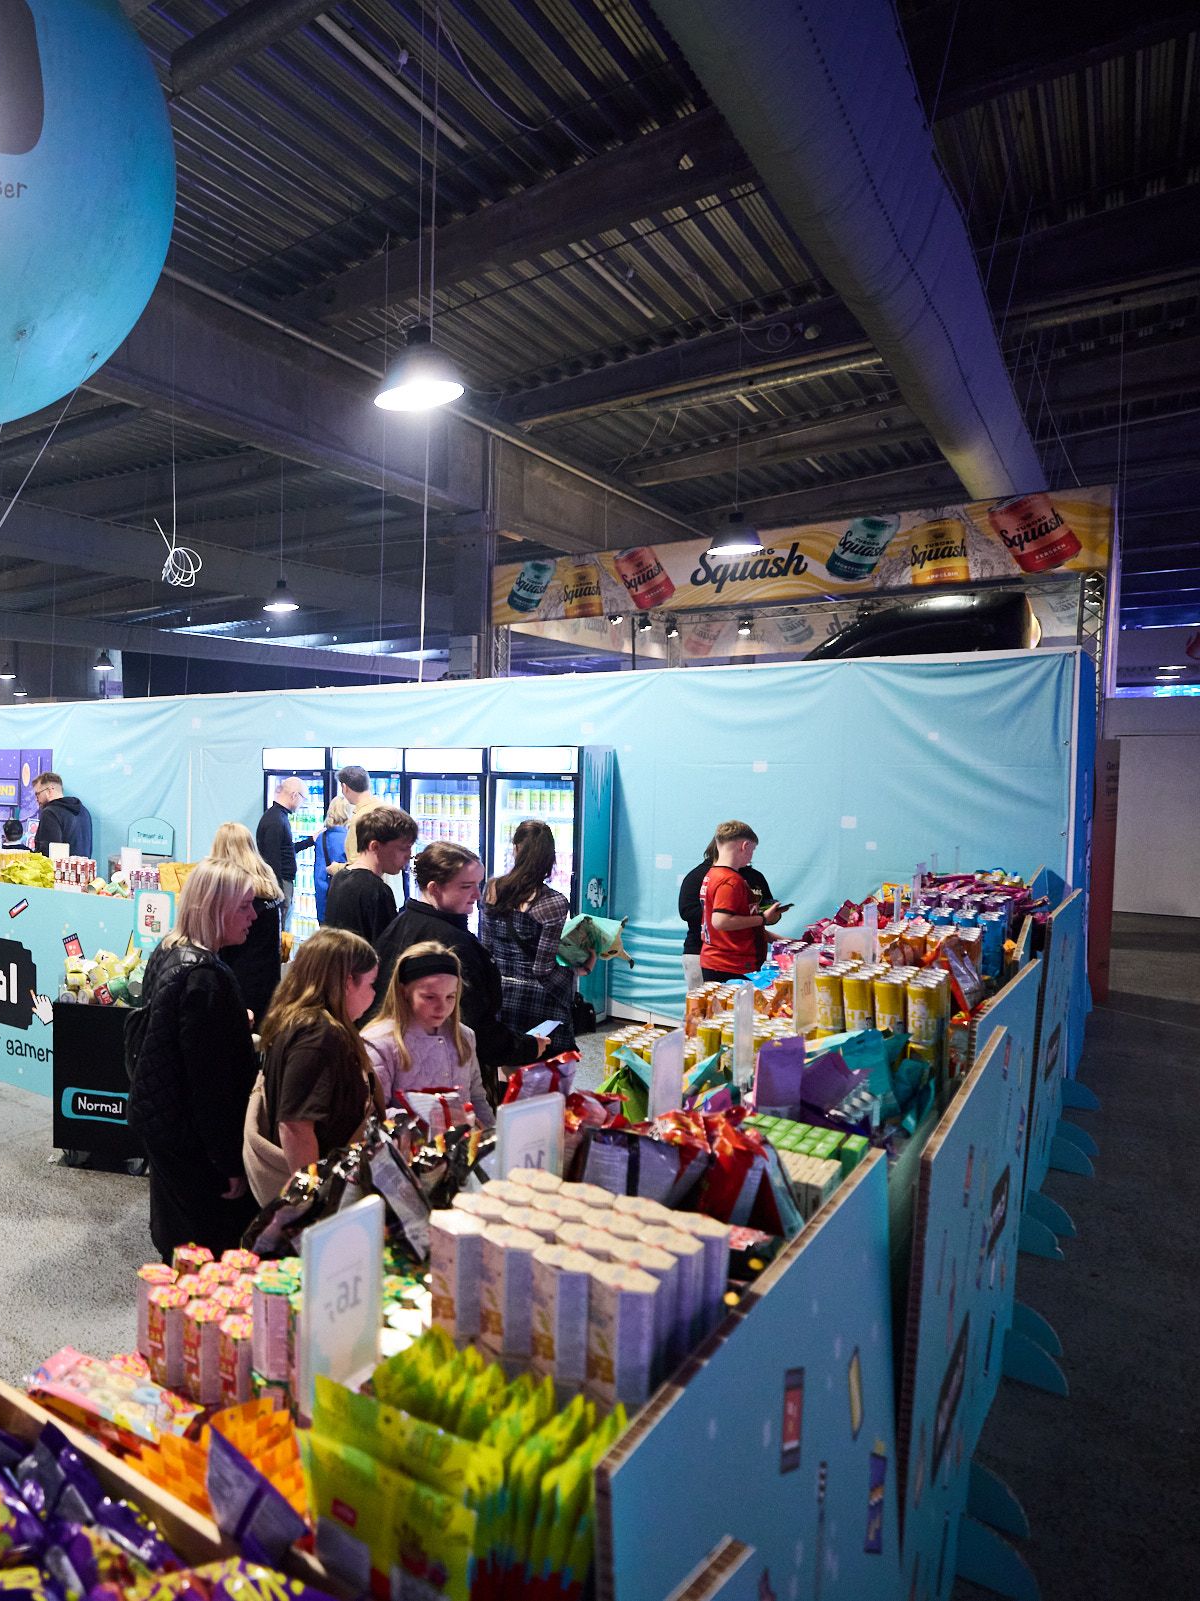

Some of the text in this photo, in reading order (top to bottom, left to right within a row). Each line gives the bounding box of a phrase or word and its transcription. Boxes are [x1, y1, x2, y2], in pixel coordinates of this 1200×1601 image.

[838, 530, 890, 558] Squash
[1000, 507, 1065, 552] Squash
[690, 542, 808, 593] Squash
[910, 538, 968, 569] Squash
[515, 571, 547, 595] Squash
[621, 559, 664, 591] Squash
[563, 580, 601, 604] Squash
[77, 1096, 122, 1115] Normal
